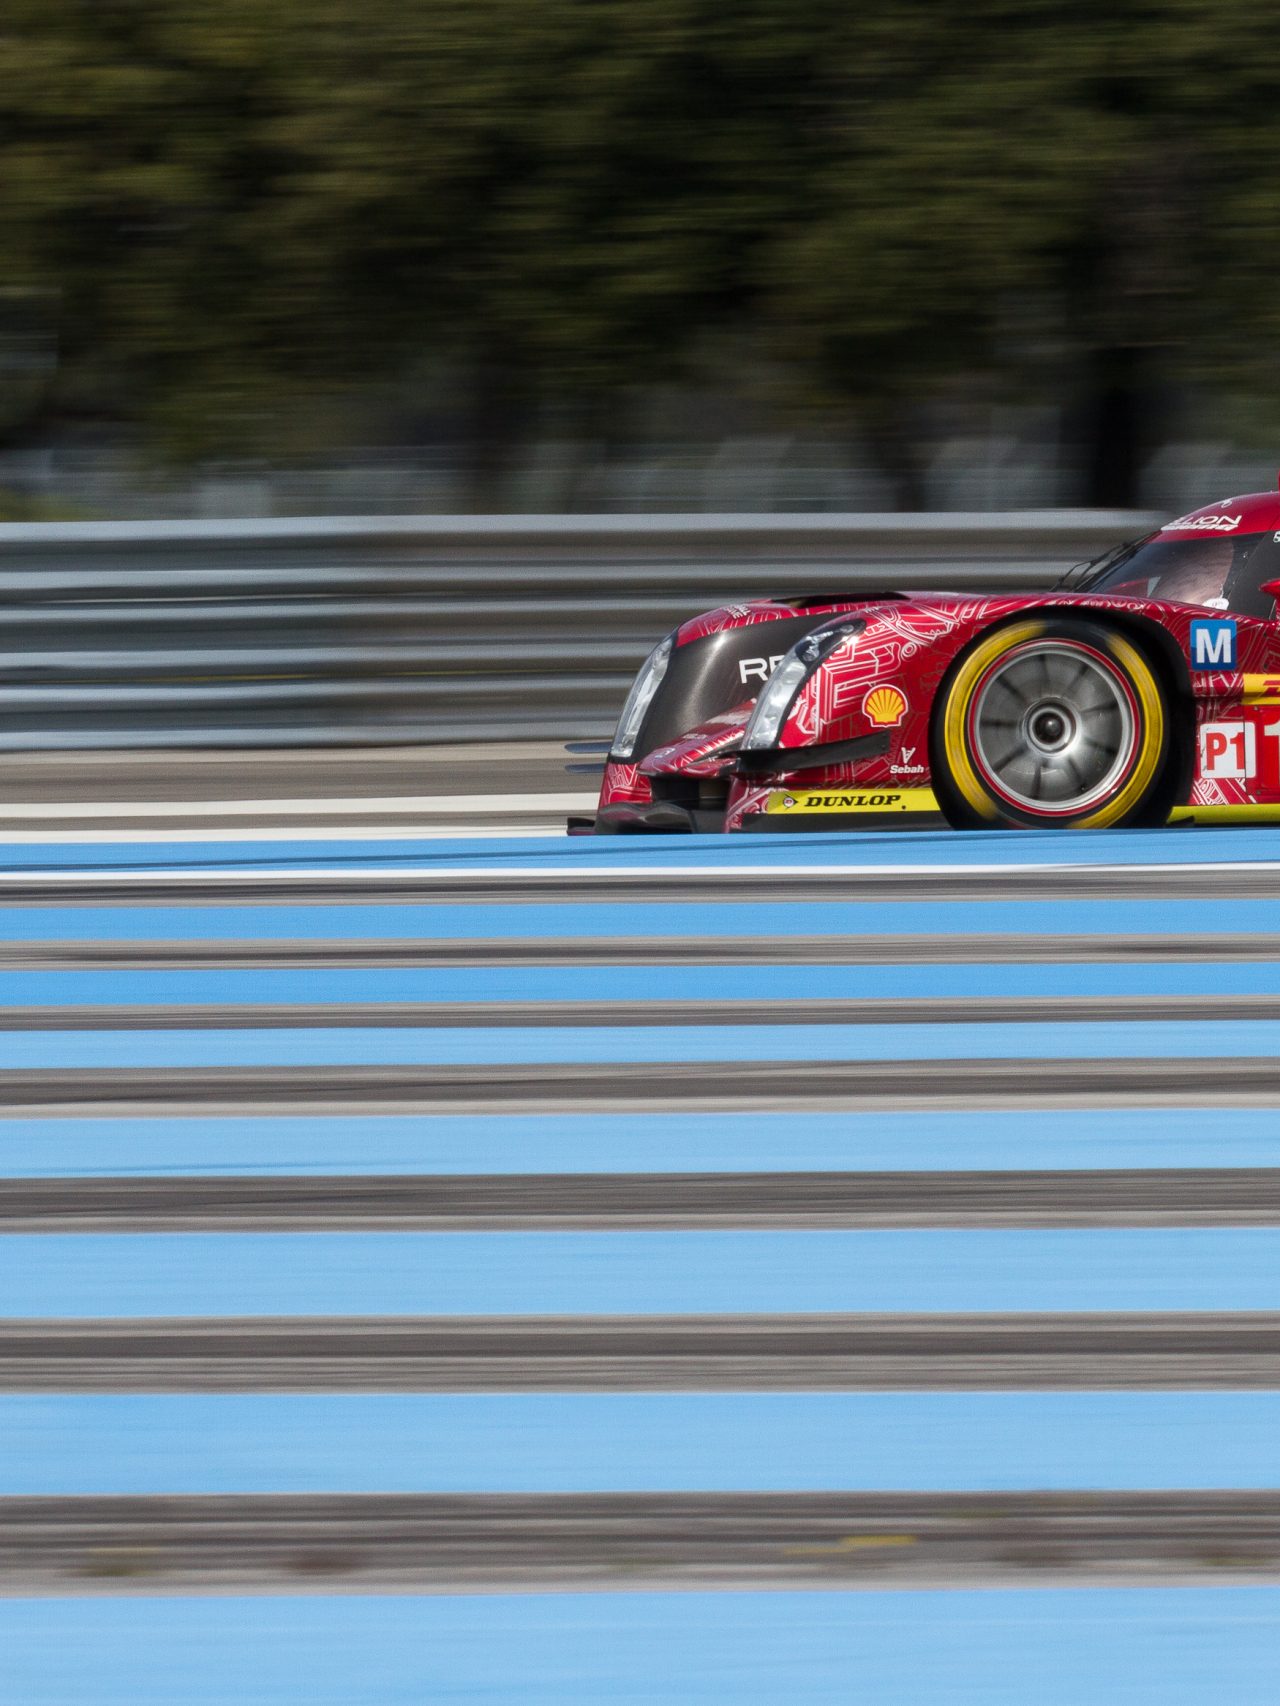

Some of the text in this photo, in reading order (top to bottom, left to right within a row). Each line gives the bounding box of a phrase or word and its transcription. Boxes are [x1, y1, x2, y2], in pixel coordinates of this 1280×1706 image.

[1195, 628, 1232, 664] M
[1205, 731, 1246, 771] P1
[889, 764, 925, 774] Sebah
[804, 794, 902, 807] DUNLOP
